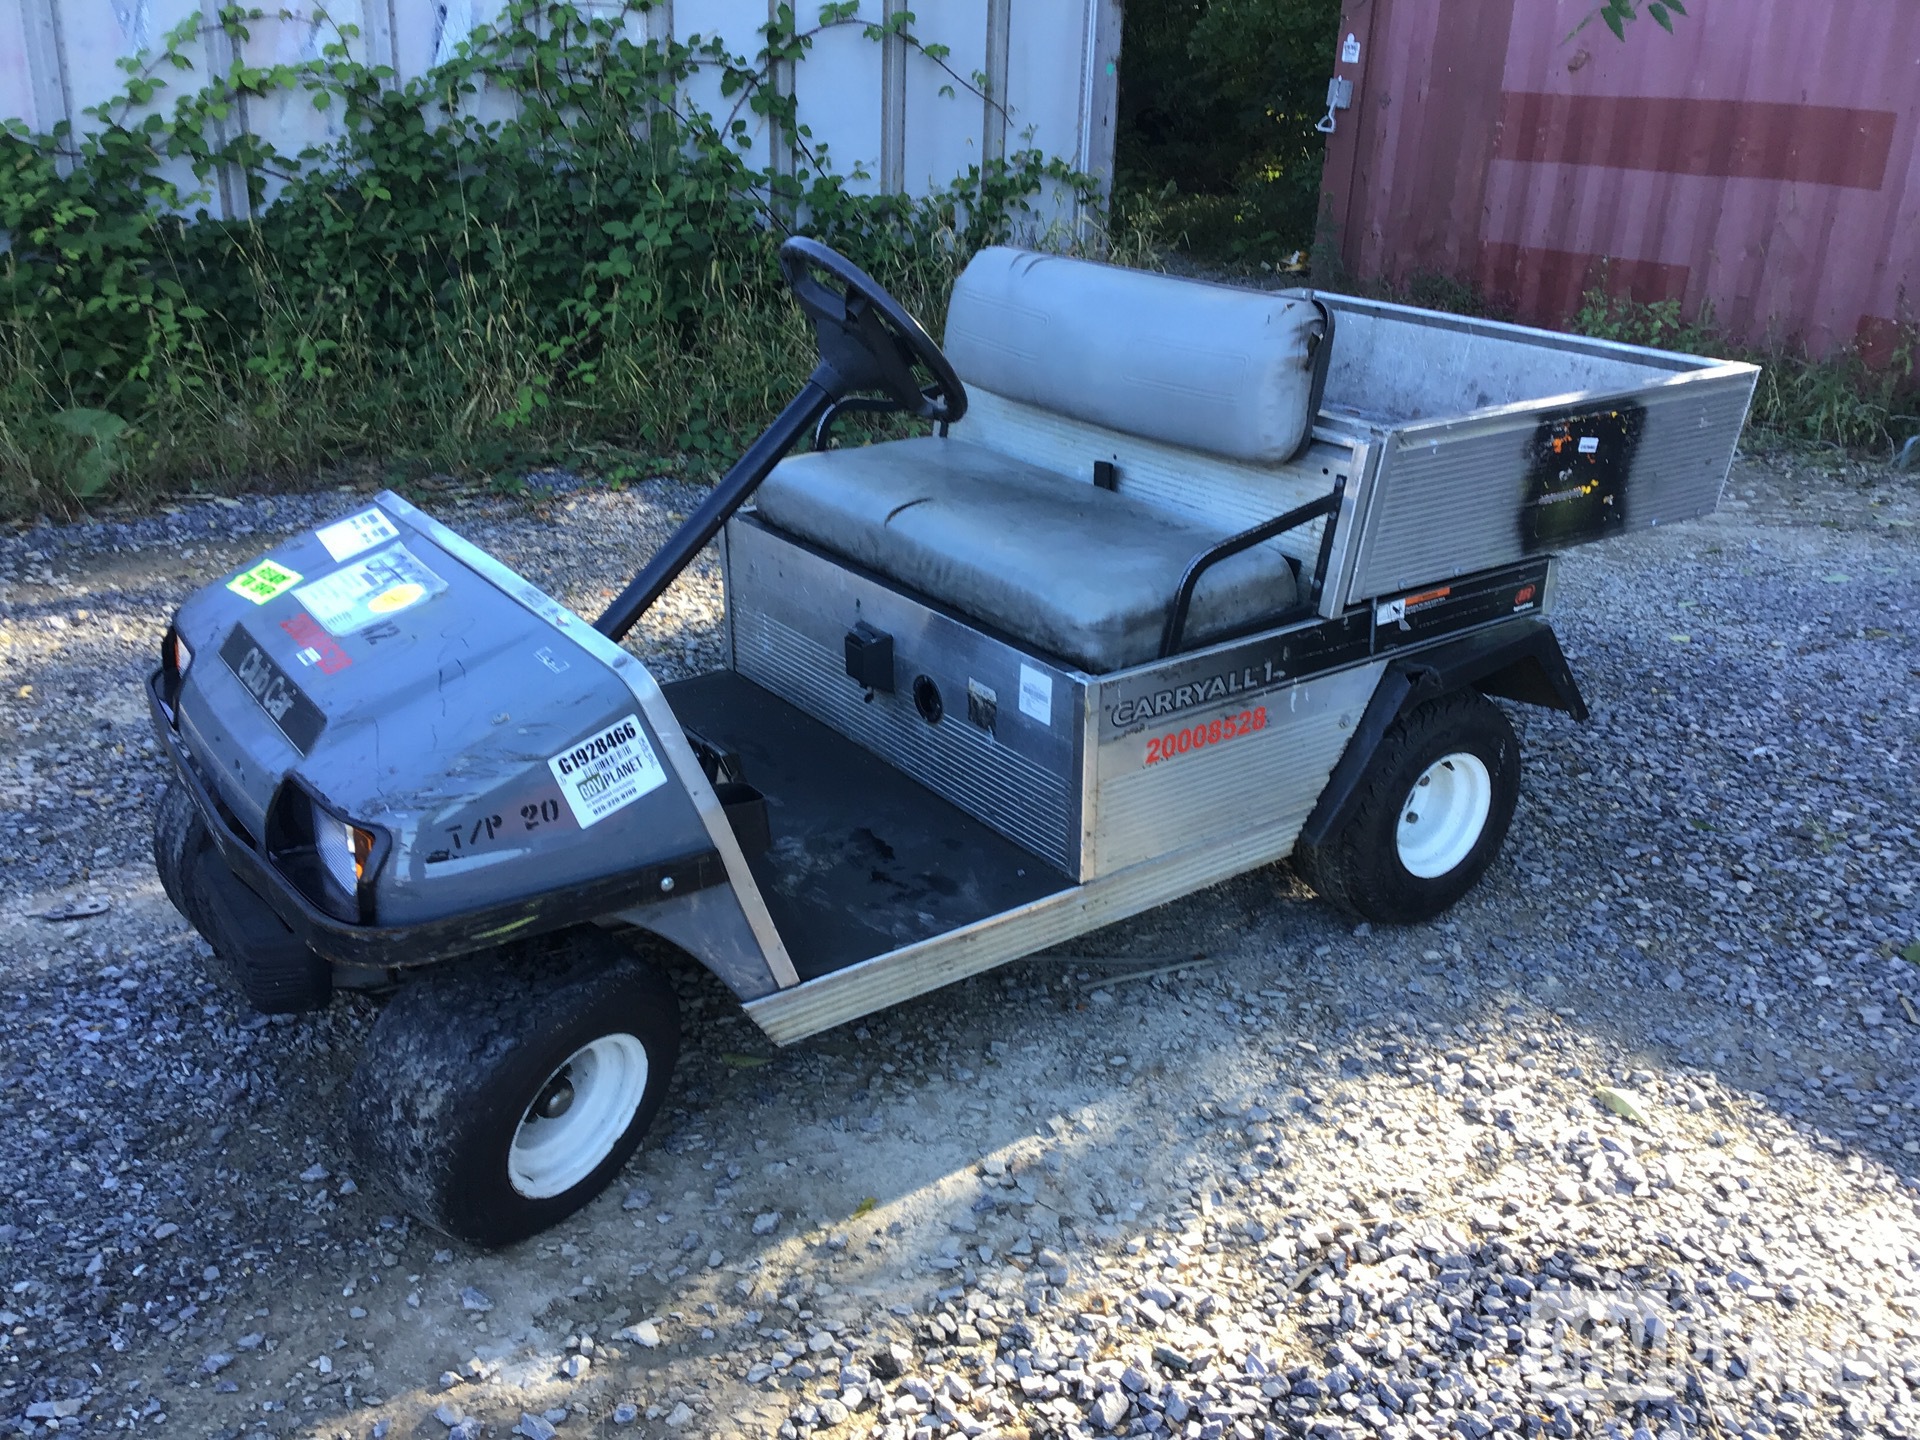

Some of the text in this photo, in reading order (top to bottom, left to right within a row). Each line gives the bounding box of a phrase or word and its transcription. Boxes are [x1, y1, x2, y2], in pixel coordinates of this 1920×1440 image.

[1111, 667, 1258, 728] CARRYALL
[558, 721, 637, 775] G1928466
[1145, 706, 1266, 765] 20008528
